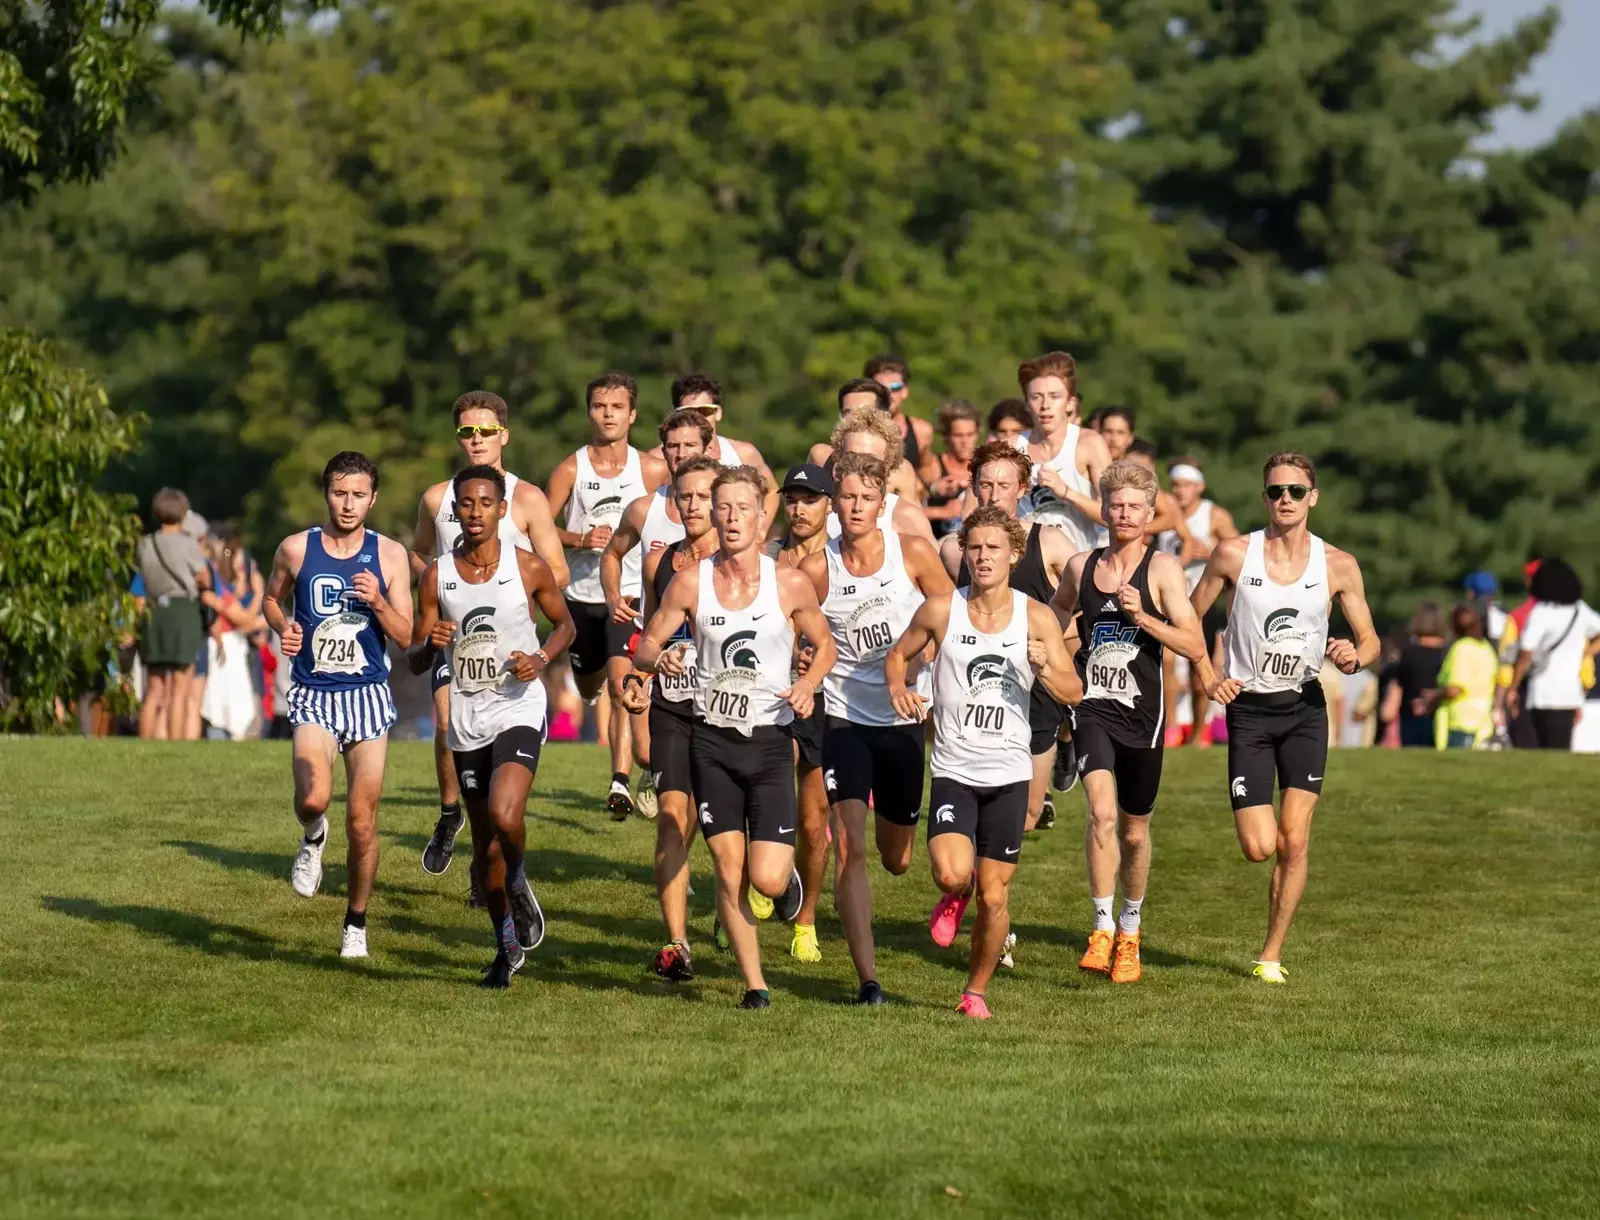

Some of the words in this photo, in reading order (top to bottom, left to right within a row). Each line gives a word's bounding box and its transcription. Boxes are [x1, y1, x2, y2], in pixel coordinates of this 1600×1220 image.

[592, 505, 625, 517] SPARTA
[458, 634, 497, 649] SPARTAN
[852, 621, 893, 652] 7069
[317, 638, 355, 662] 7234
[1095, 643, 1134, 656] SPARTAN
[458, 657, 497, 680] 7076
[716, 668, 758, 681] SPARTAN
[1261, 651, 1301, 676] 7067
[969, 680, 1012, 695] SPARTAN
[1092, 664, 1127, 690] 6978
[709, 689, 749, 718] 7078
[964, 703, 1005, 730] 7070
